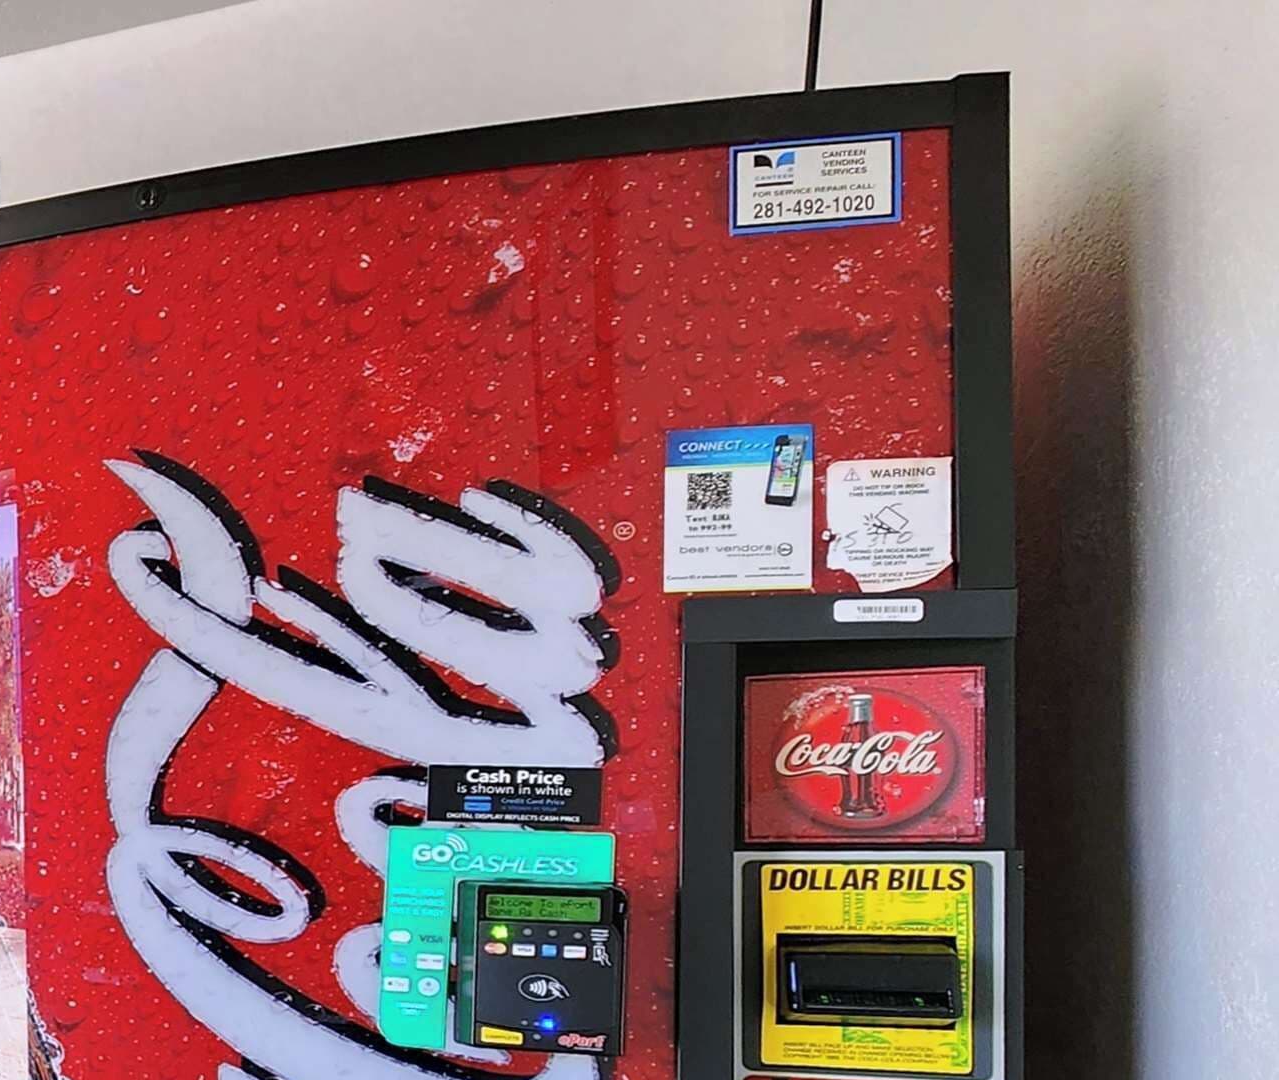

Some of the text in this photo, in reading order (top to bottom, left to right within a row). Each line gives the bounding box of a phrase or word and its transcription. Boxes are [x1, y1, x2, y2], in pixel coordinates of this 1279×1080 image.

[821, 149, 866, 158] CANTEEN
[823, 158, 865, 167] VENDING
[821, 167, 867, 176] SERVICES
[774, 187, 811, 196] SERVICE
[814, 185, 847, 193] REPAIR
[754, 193, 874, 219] 281-492-1020
[678, 440, 741, 453] CONNECT
[870, 466, 936, 478] WARNING
[685, 515, 707, 523] Text
[679, 544, 772, 554] best vendors
[775, 731, 943, 776] Coca-Cola
[466, 769, 565, 785] Cash Price
[457, 783, 572, 796] is shown in white
[413, 844, 578, 876] GO CASHLESS
[769, 868, 966, 891] DOLLAR BILLS
[557, 1034, 607, 1050] ePort
